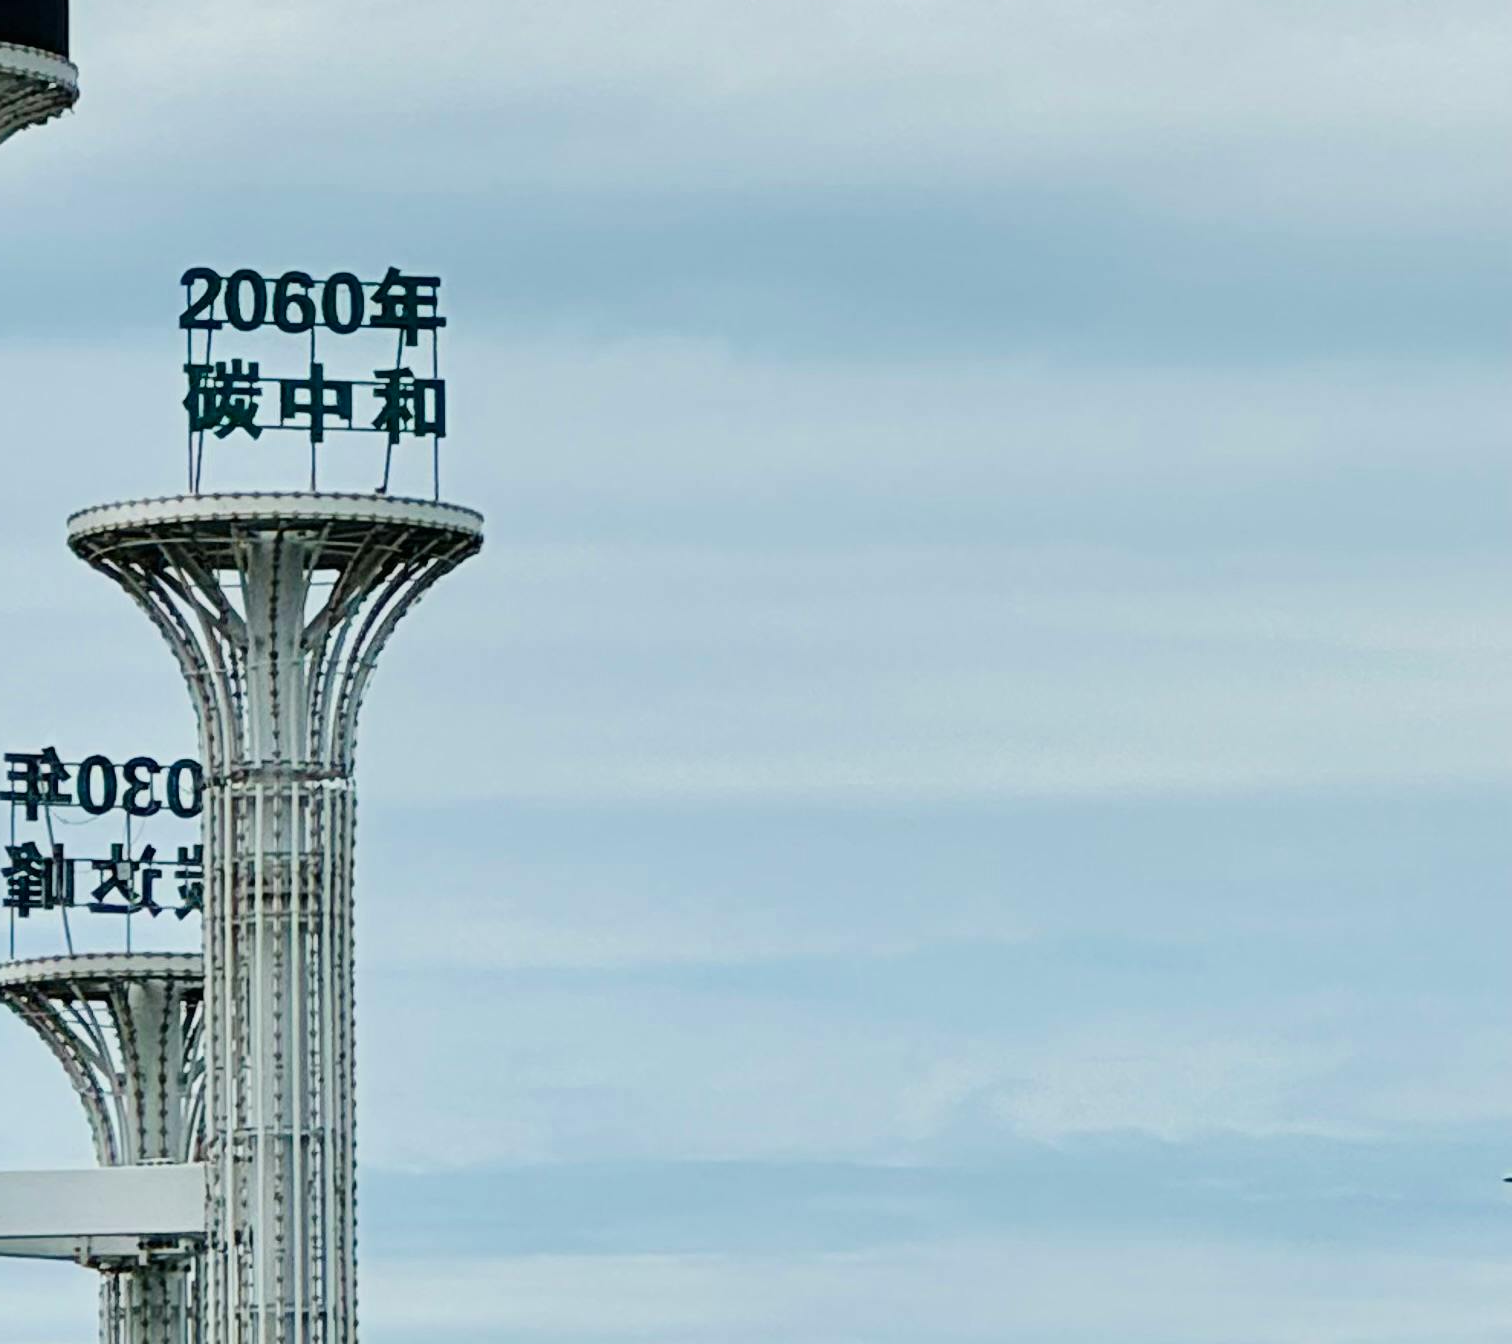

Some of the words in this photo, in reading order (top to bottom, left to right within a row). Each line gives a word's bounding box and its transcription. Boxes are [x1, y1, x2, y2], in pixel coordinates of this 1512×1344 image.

[179, 267, 446, 346] 2060年
[182, 358, 446, 444] 碳中和
